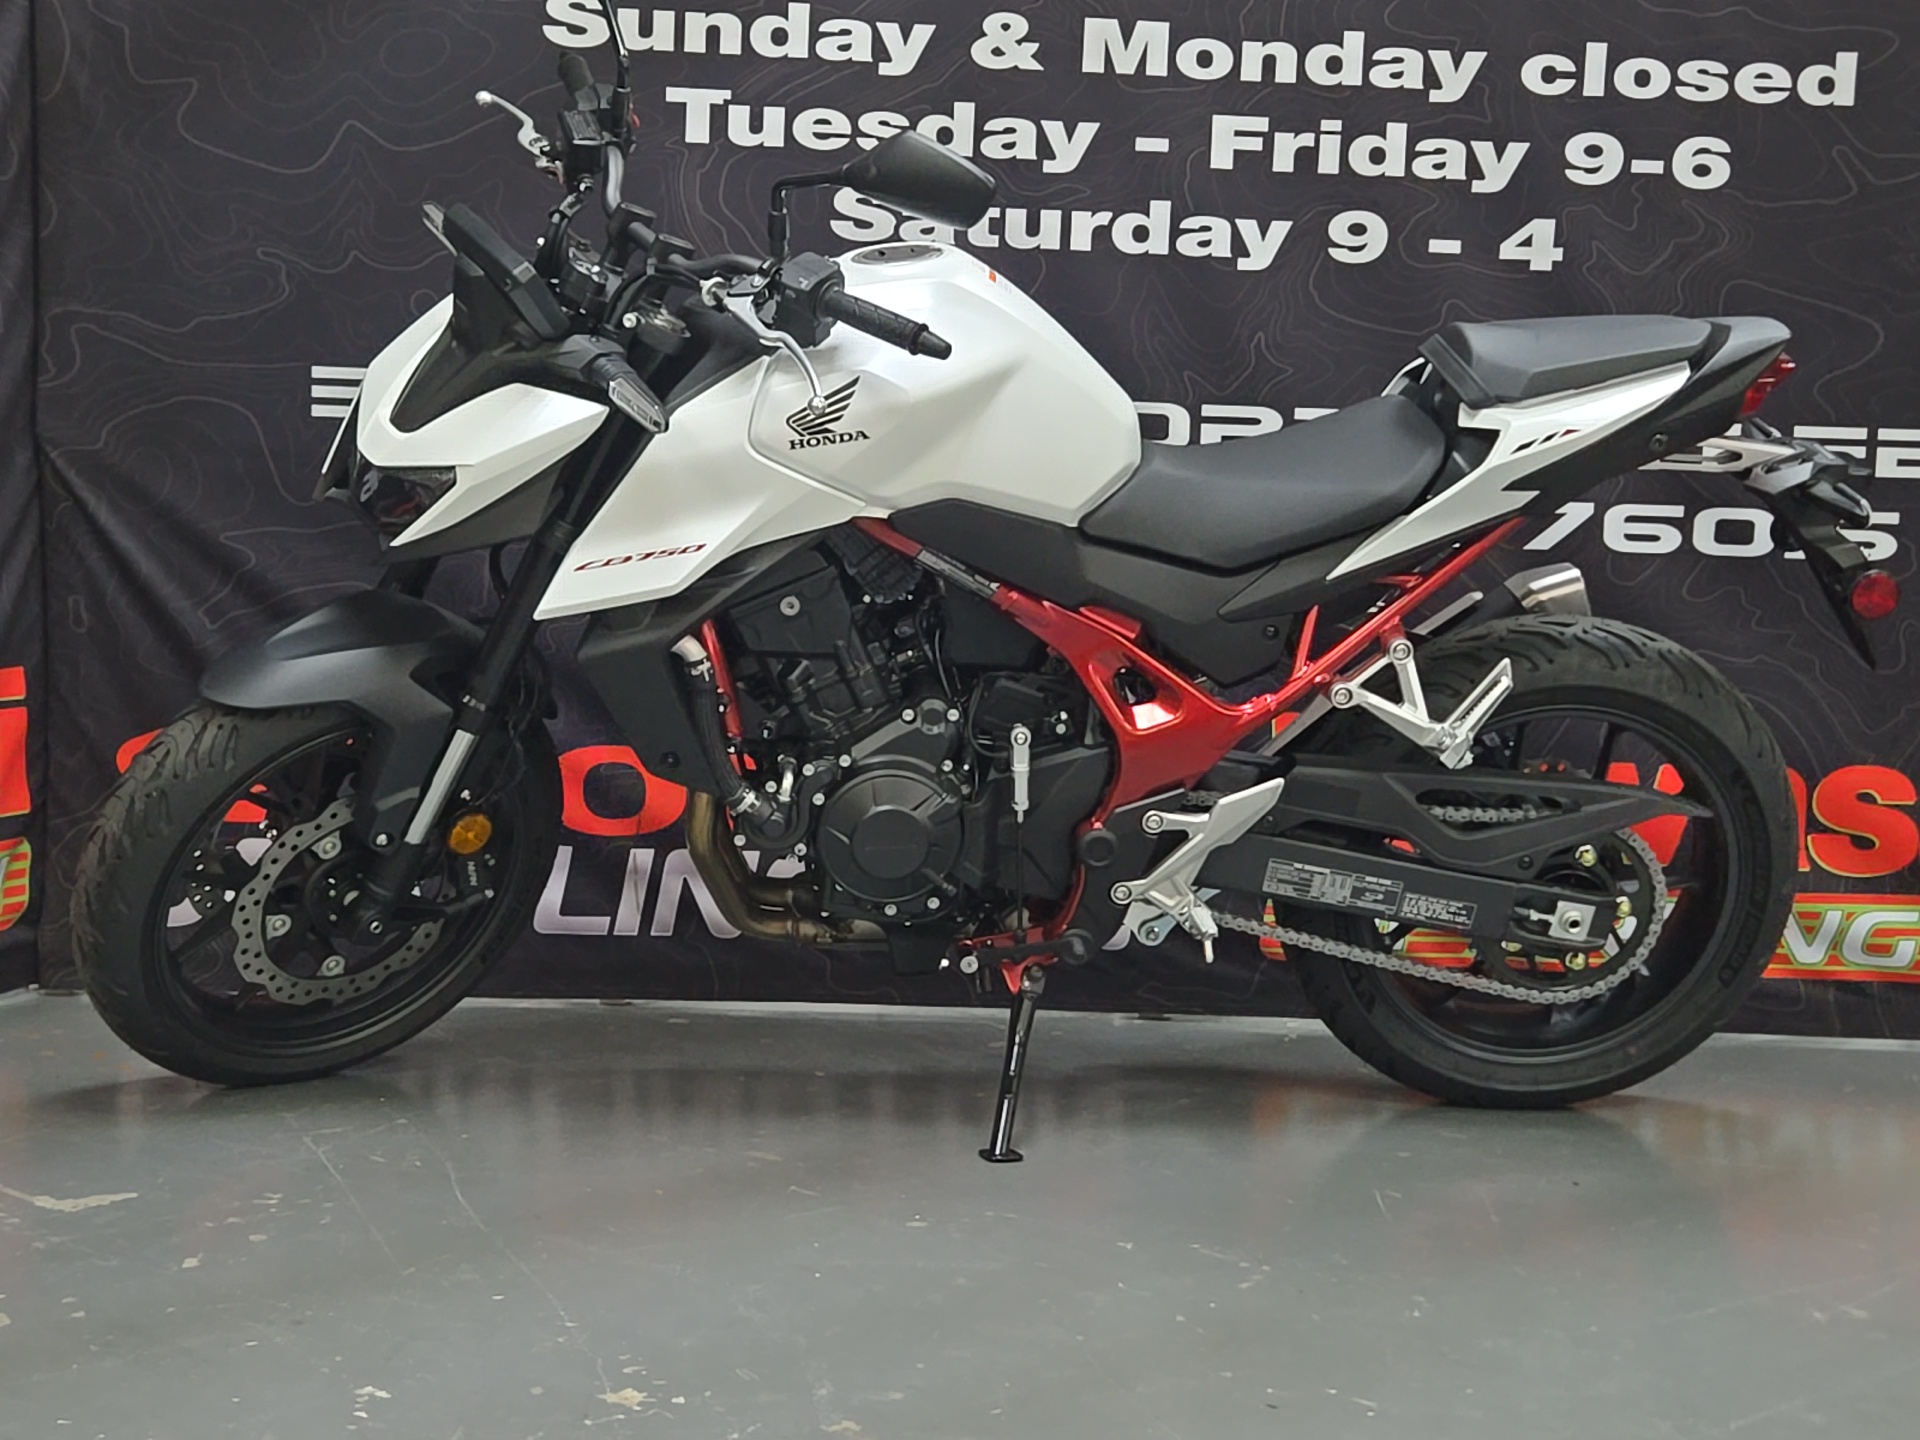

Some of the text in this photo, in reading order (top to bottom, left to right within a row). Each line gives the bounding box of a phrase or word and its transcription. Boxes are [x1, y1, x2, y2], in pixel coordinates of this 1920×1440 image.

[542, 0, 1859, 106] Sunday & Monday closed
[665, 87, 1732, 193] Tuesday - Friday 9-6
[1328, 211, 1389, 264] 9
[1428, 239, 1462, 254] -
[1499, 219, 1564, 272] 4
[788, 430, 871, 450] HONDA
